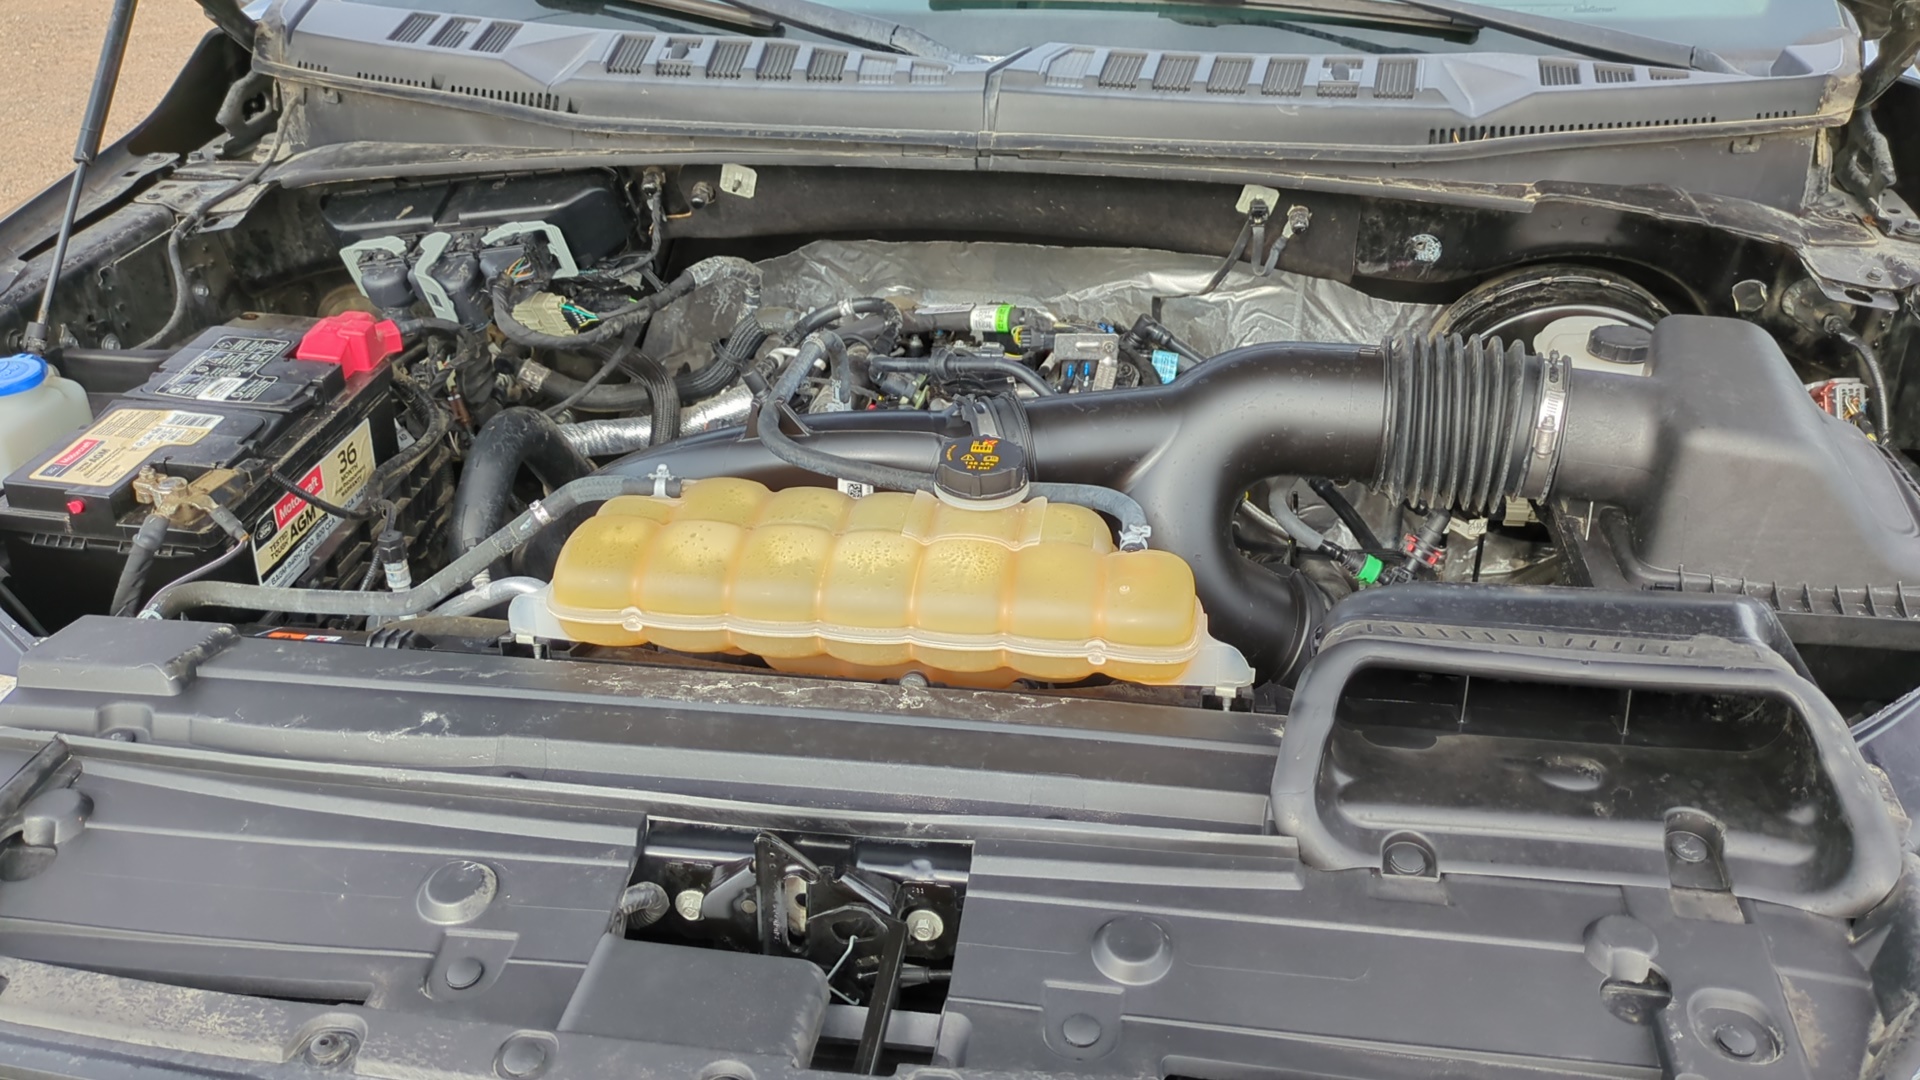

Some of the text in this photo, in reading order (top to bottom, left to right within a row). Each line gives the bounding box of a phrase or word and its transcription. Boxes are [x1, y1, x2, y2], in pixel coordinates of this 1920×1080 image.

[337, 441, 357, 474] 36
[341, 462, 359, 481] MONTH
[290, 505, 317, 540] AGM
[269, 530, 289, 552] TESTED
